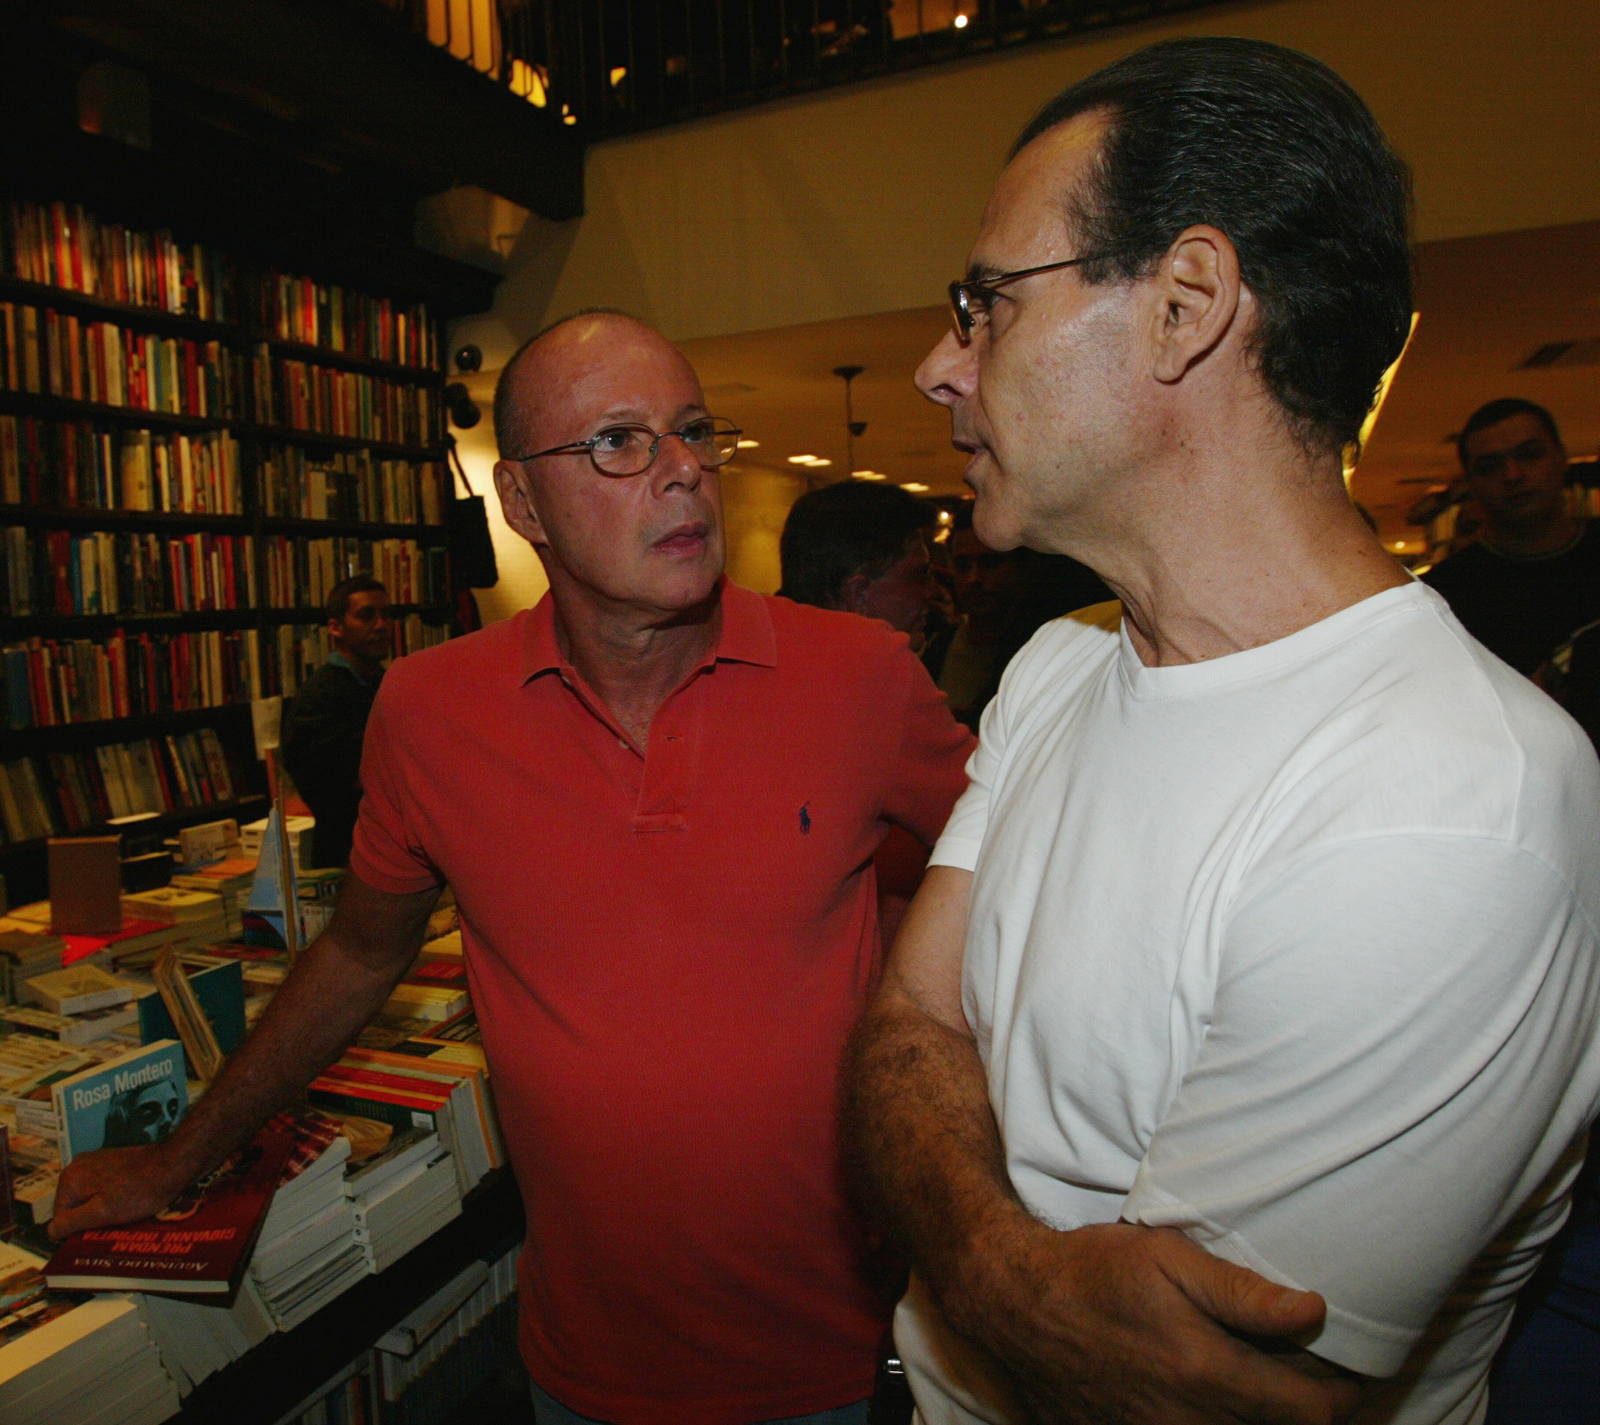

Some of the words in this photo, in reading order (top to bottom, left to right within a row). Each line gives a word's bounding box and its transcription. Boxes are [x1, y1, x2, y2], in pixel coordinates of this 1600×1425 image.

[72, 1083, 111, 1112] Rosa
[114, 1059, 174, 1095] Montero
[163, 1228, 236, 1241] GIOVANNI
[111, 1242, 193, 1254] PRENDAM
[74, 1258, 113, 1268] SILVA
